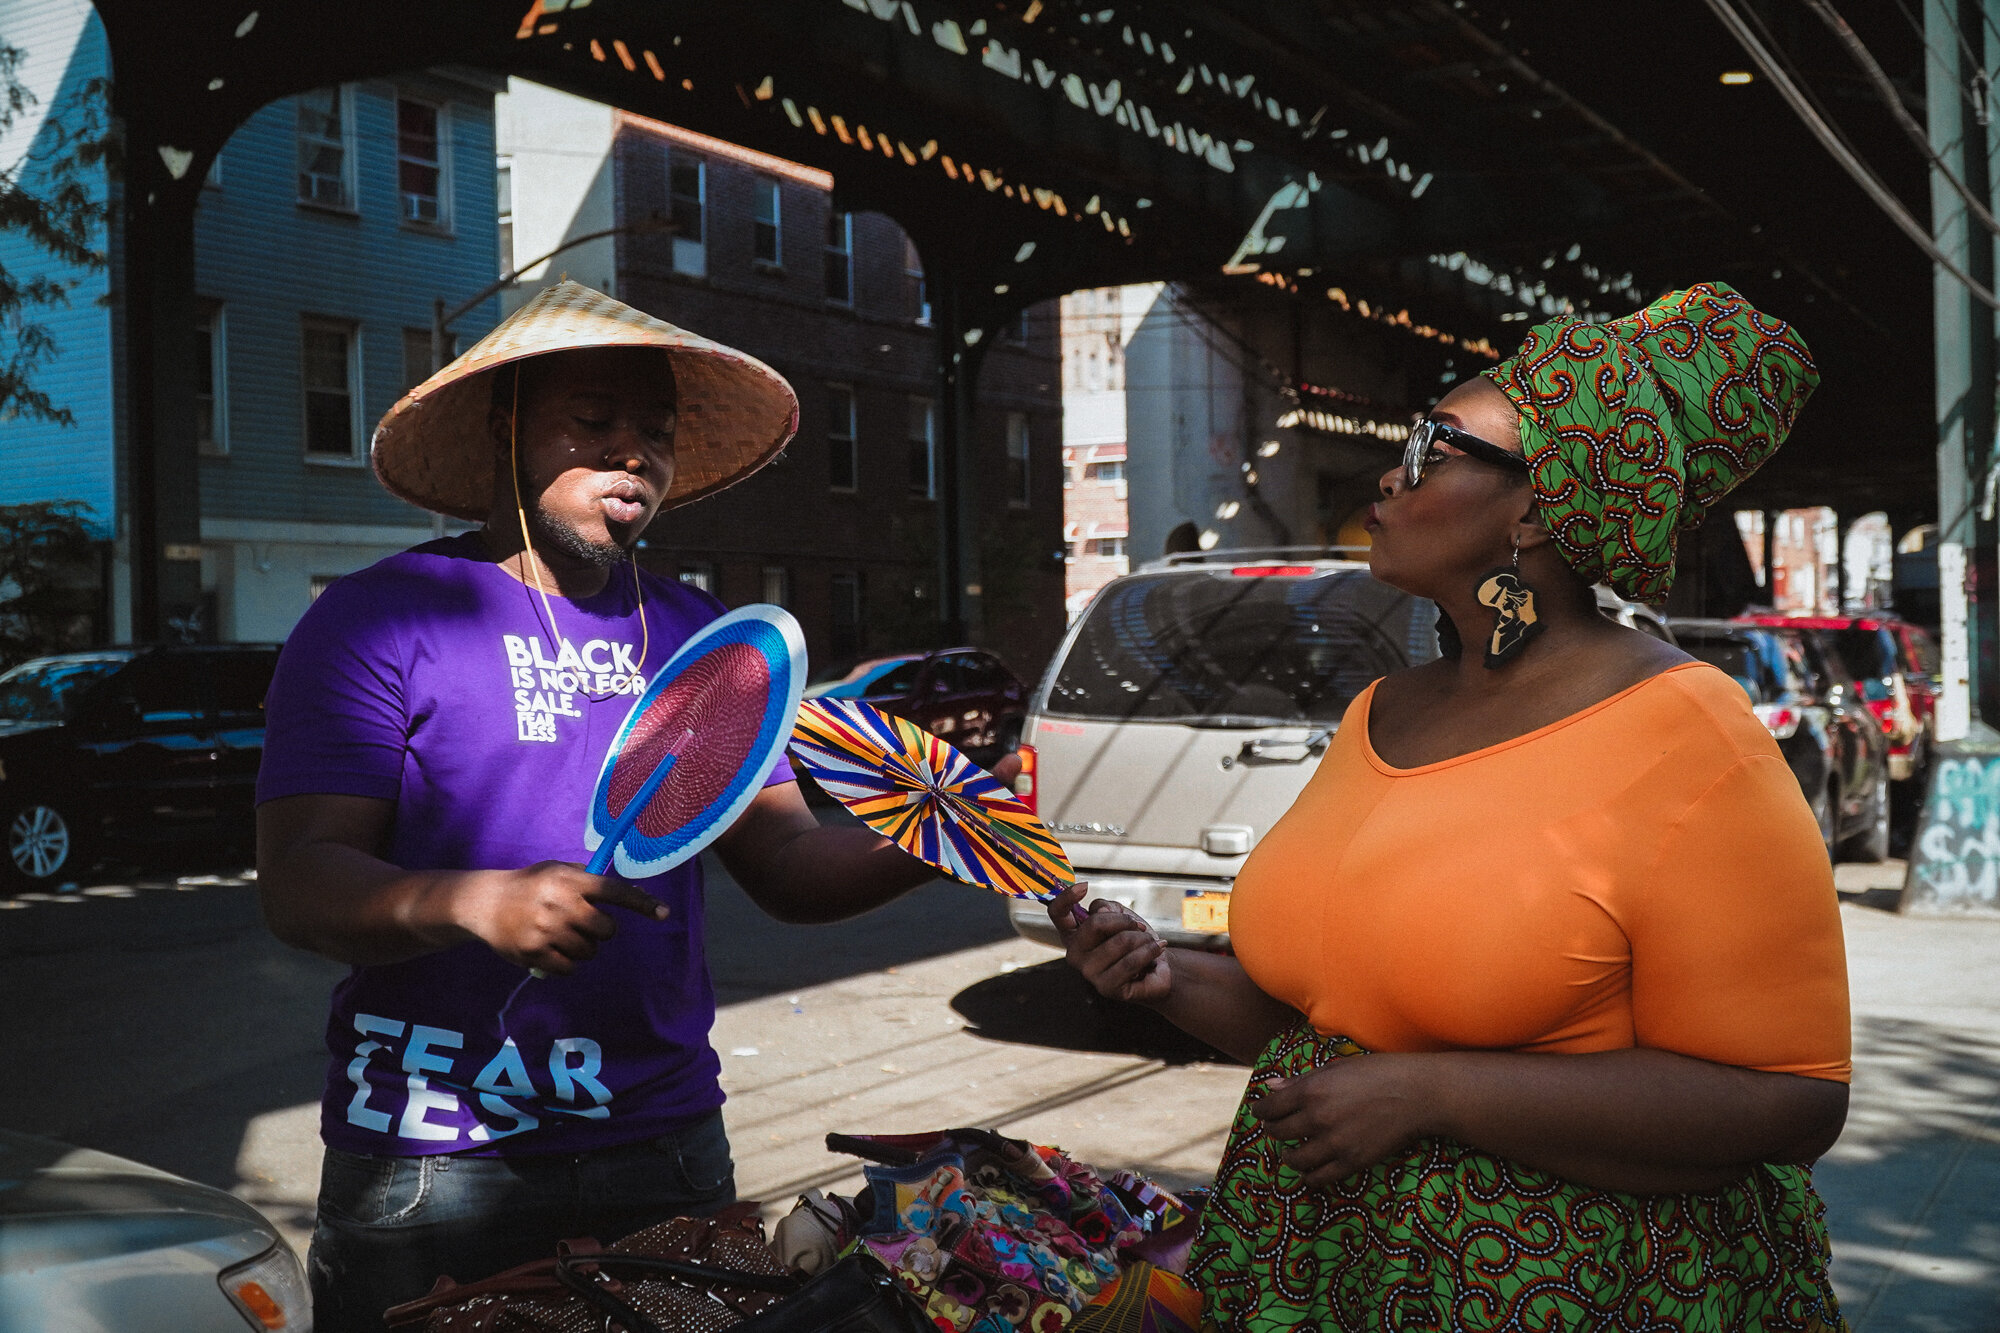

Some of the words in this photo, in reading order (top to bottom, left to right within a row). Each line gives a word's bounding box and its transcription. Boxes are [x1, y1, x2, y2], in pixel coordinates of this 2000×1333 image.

[503, 634, 641, 674] BLACK
[510, 667, 536, 689] IS
[539, 669, 591, 694] NOT
[594, 673, 647, 696] FOR
[514, 688, 582, 718] SALE.
[516, 711, 555, 728] FEAR
[518, 721, 557, 743] LESS
[346, 1056, 611, 1142] LES
